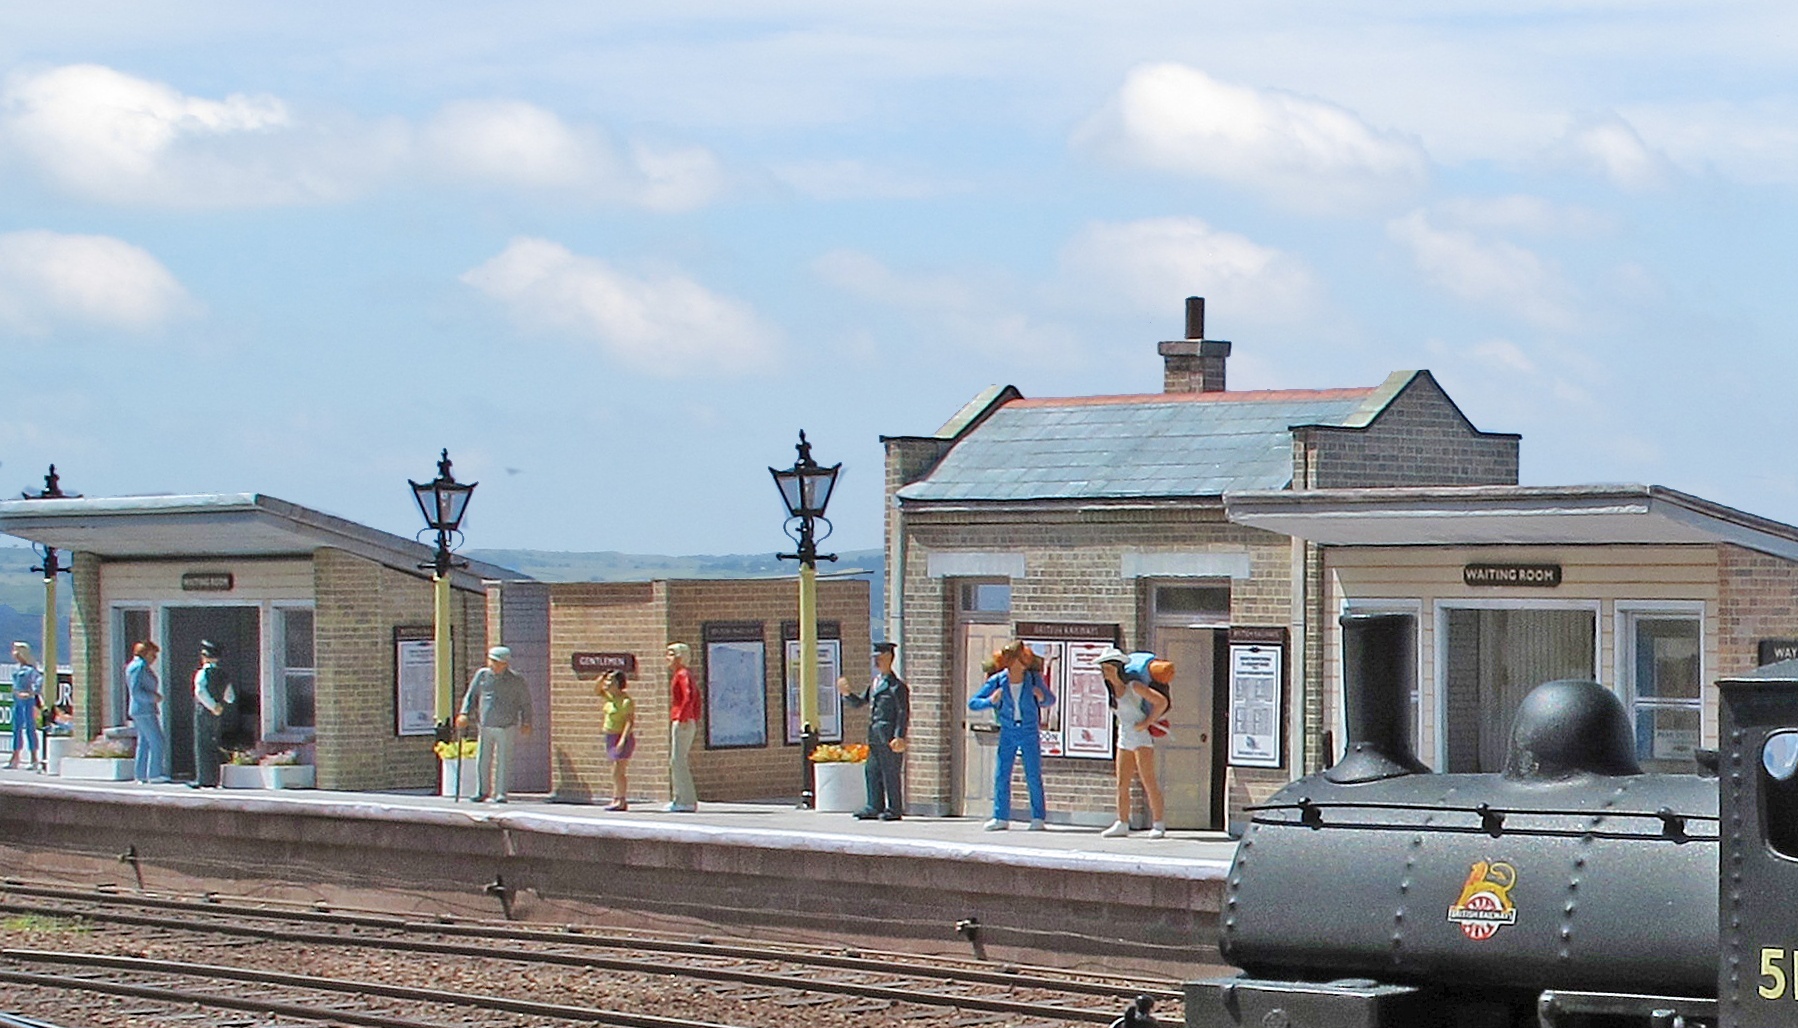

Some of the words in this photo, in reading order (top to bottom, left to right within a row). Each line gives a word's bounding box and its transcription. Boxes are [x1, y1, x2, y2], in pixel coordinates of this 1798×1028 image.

[1465, 569, 1517, 581] WAITING
[1519, 569, 1554, 581] ROOM
[1774, 647, 1798, 659] WAY
[579, 656, 625, 666] GENTLEMEN
